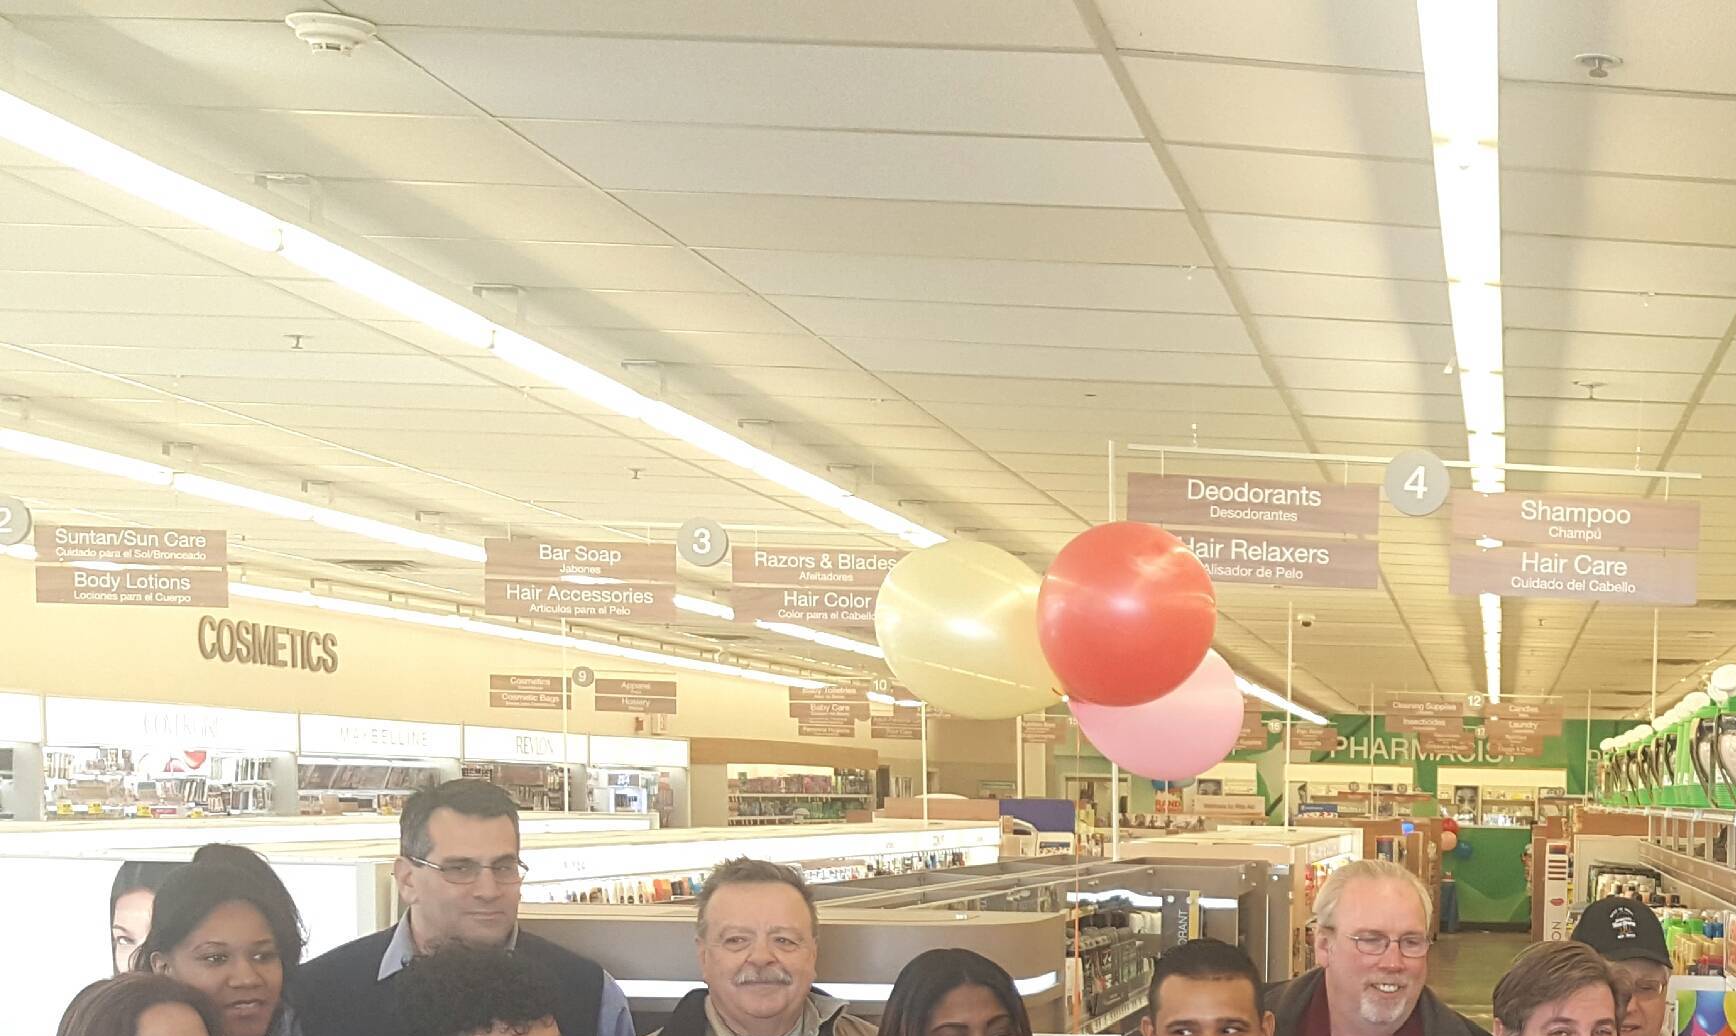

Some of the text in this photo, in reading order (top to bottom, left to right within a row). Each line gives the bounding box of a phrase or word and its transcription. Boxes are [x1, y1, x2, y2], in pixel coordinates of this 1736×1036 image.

[1403, 465, 1428, 499] 4
[1187, 478, 1322, 507] Deodorants
[0, 507, 13, 533] 2
[1210, 506, 1298, 523] Desodorantes
[1521, 500, 1632, 528] Shampoo
[55, 527, 207, 548] Suntan/Sun Care
[692, 527, 712, 554] 3
[55, 547, 97, 558] Cuidado
[540, 544, 622, 566] Bar Soap
[754, 551, 898, 571] Razors & Blades
[1176, 537, 1330, 565] Hair Relaxers
[560, 564, 602, 575] Jabones
[1203, 564, 1304, 581] Alisador de Pelo
[1521, 551, 1628, 576] Hair Care
[74, 572, 192, 592] Body Lotions
[1511, 577, 1637, 594] Cuidado del Cabello
[73, 590, 118, 602] Lociones
[157, 593, 192, 605] Cuerpo
[506, 584, 654, 605] Hair Accessories
[784, 591, 872, 609] Hair Color
[777, 609, 805, 621] Color
[199, 614, 340, 674] COSMETICS
[578, 669, 587, 683] 9
[872, 680, 888, 691] 10
[1467, 695, 1481, 708] 12
